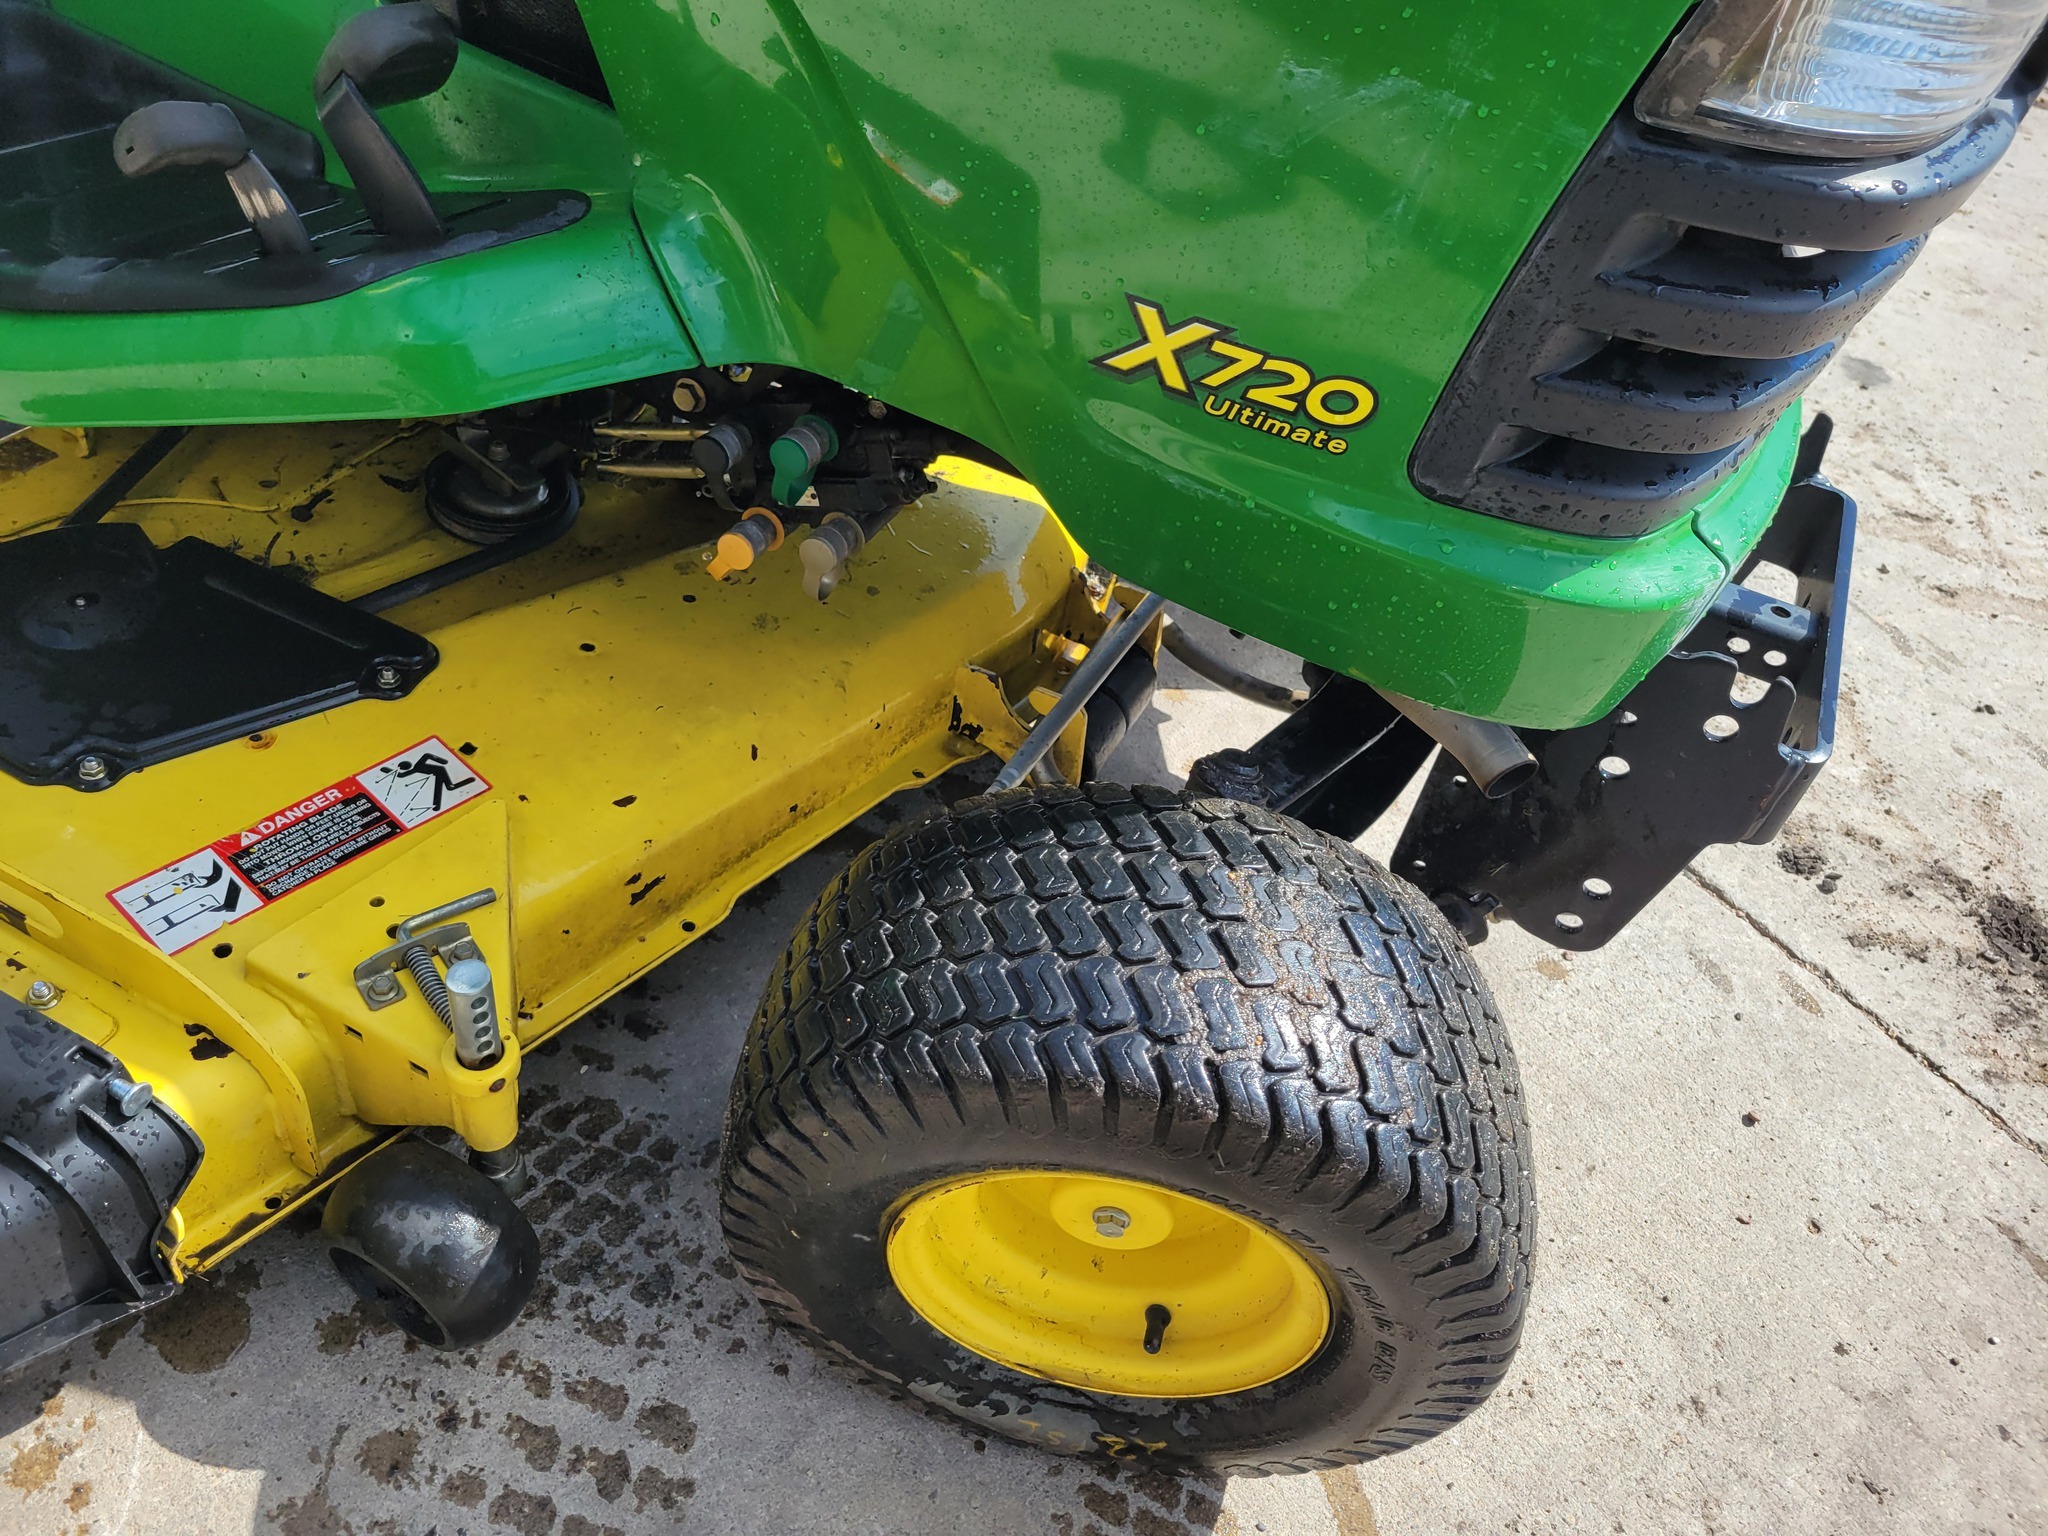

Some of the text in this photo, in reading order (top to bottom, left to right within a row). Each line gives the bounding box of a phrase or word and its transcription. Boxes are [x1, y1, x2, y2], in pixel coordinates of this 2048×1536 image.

[1092, 295, 1377, 428] X720
[1203, 394, 1348, 455] Ultimate
[237, 798, 367, 864] DO NOT PUT HANDS OR FEET UNDER OR
[241, 858, 260, 869] INTO
[259, 844, 288, 860] MOWER
[286, 833, 308, 846] WHEN
[307, 821, 334, 836] ENGINE
[340, 802, 372, 819] RUNNING
[253, 803, 345, 850] ROTATING BLADE
[256, 788, 343, 834] DANGER
[262, 814, 360, 866] THROWN OBJECTS
[250, 862, 279, 879] BEFORE
[304, 838, 327, 851] CLEAR
[325, 829, 345, 841] AREA
[342, 824, 354, 832] OF
[351, 810, 381, 827] OBJECTS
[255, 870, 276, 883] THAT
[273, 863, 290, 873] MAY
[289, 857, 301, 865] BE
[299, 842, 331, 860] THROWN
[338, 826, 363, 840] BLADE
[264, 823, 388, 889] DO NOT OPERATE MOWER WITHOUT
[267, 826, 391, 892] DISCHARGE CHUTE OR ENTIRE GRASS
[271, 876, 306, 896] CATCHER
[313, 860, 337, 874] PLACE
